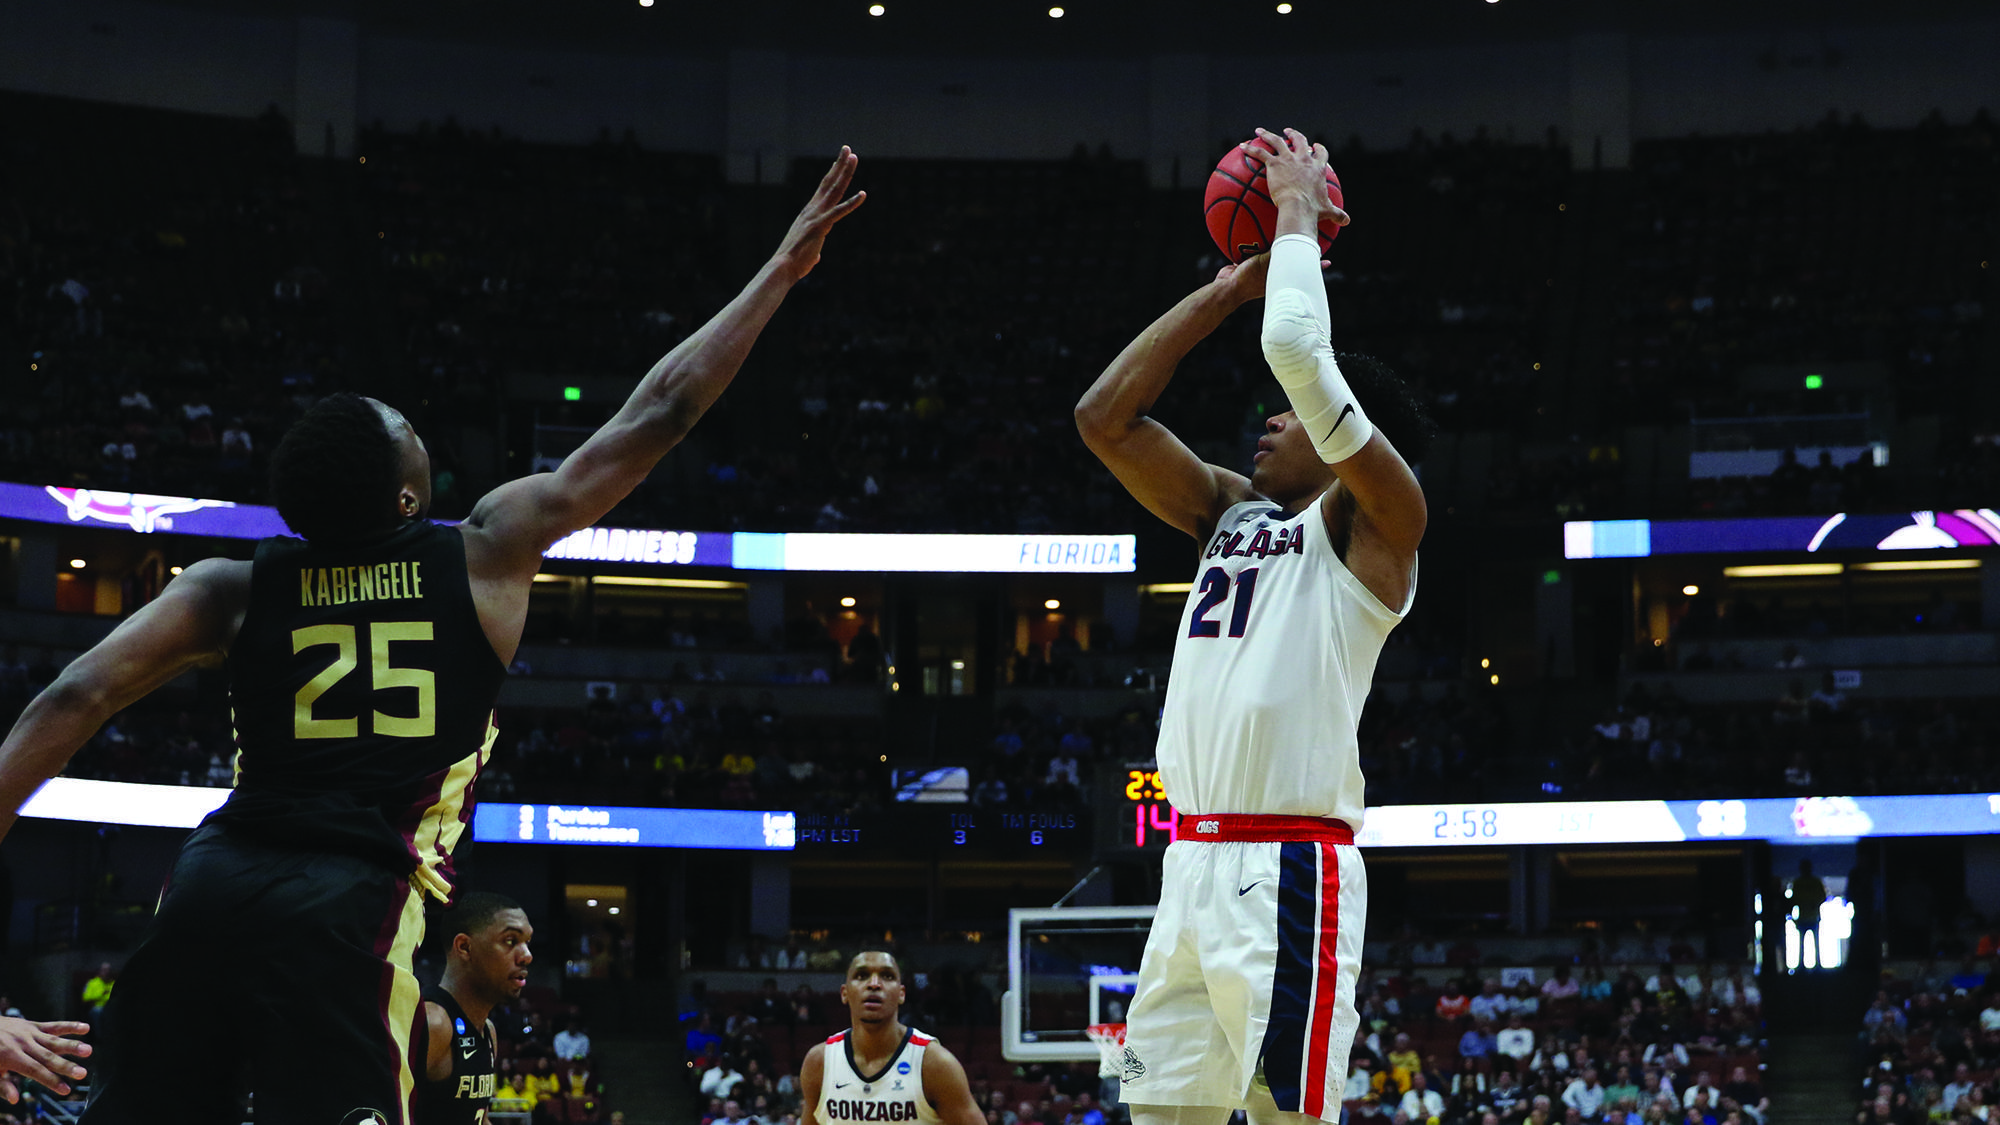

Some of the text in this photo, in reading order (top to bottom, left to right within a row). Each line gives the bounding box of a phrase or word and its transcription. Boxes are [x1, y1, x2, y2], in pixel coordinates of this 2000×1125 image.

[1019, 542, 1121, 565] FLORIDA
[301, 562, 423, 606] KABENGELE
[1188, 566, 1259, 638] 21
[291, 621, 436, 740] 25
[951, 814, 976, 828] TOL
[1029, 814, 1076, 829] FOULS
[1136, 803, 1179, 847] 14
[1434, 809, 1498, 838] 2:58
[831, 829, 860, 842] EST
[953, 830, 966, 845] 3
[1030, 830, 1043, 845] 6
[826, 1098, 918, 1122] GONZAGA
